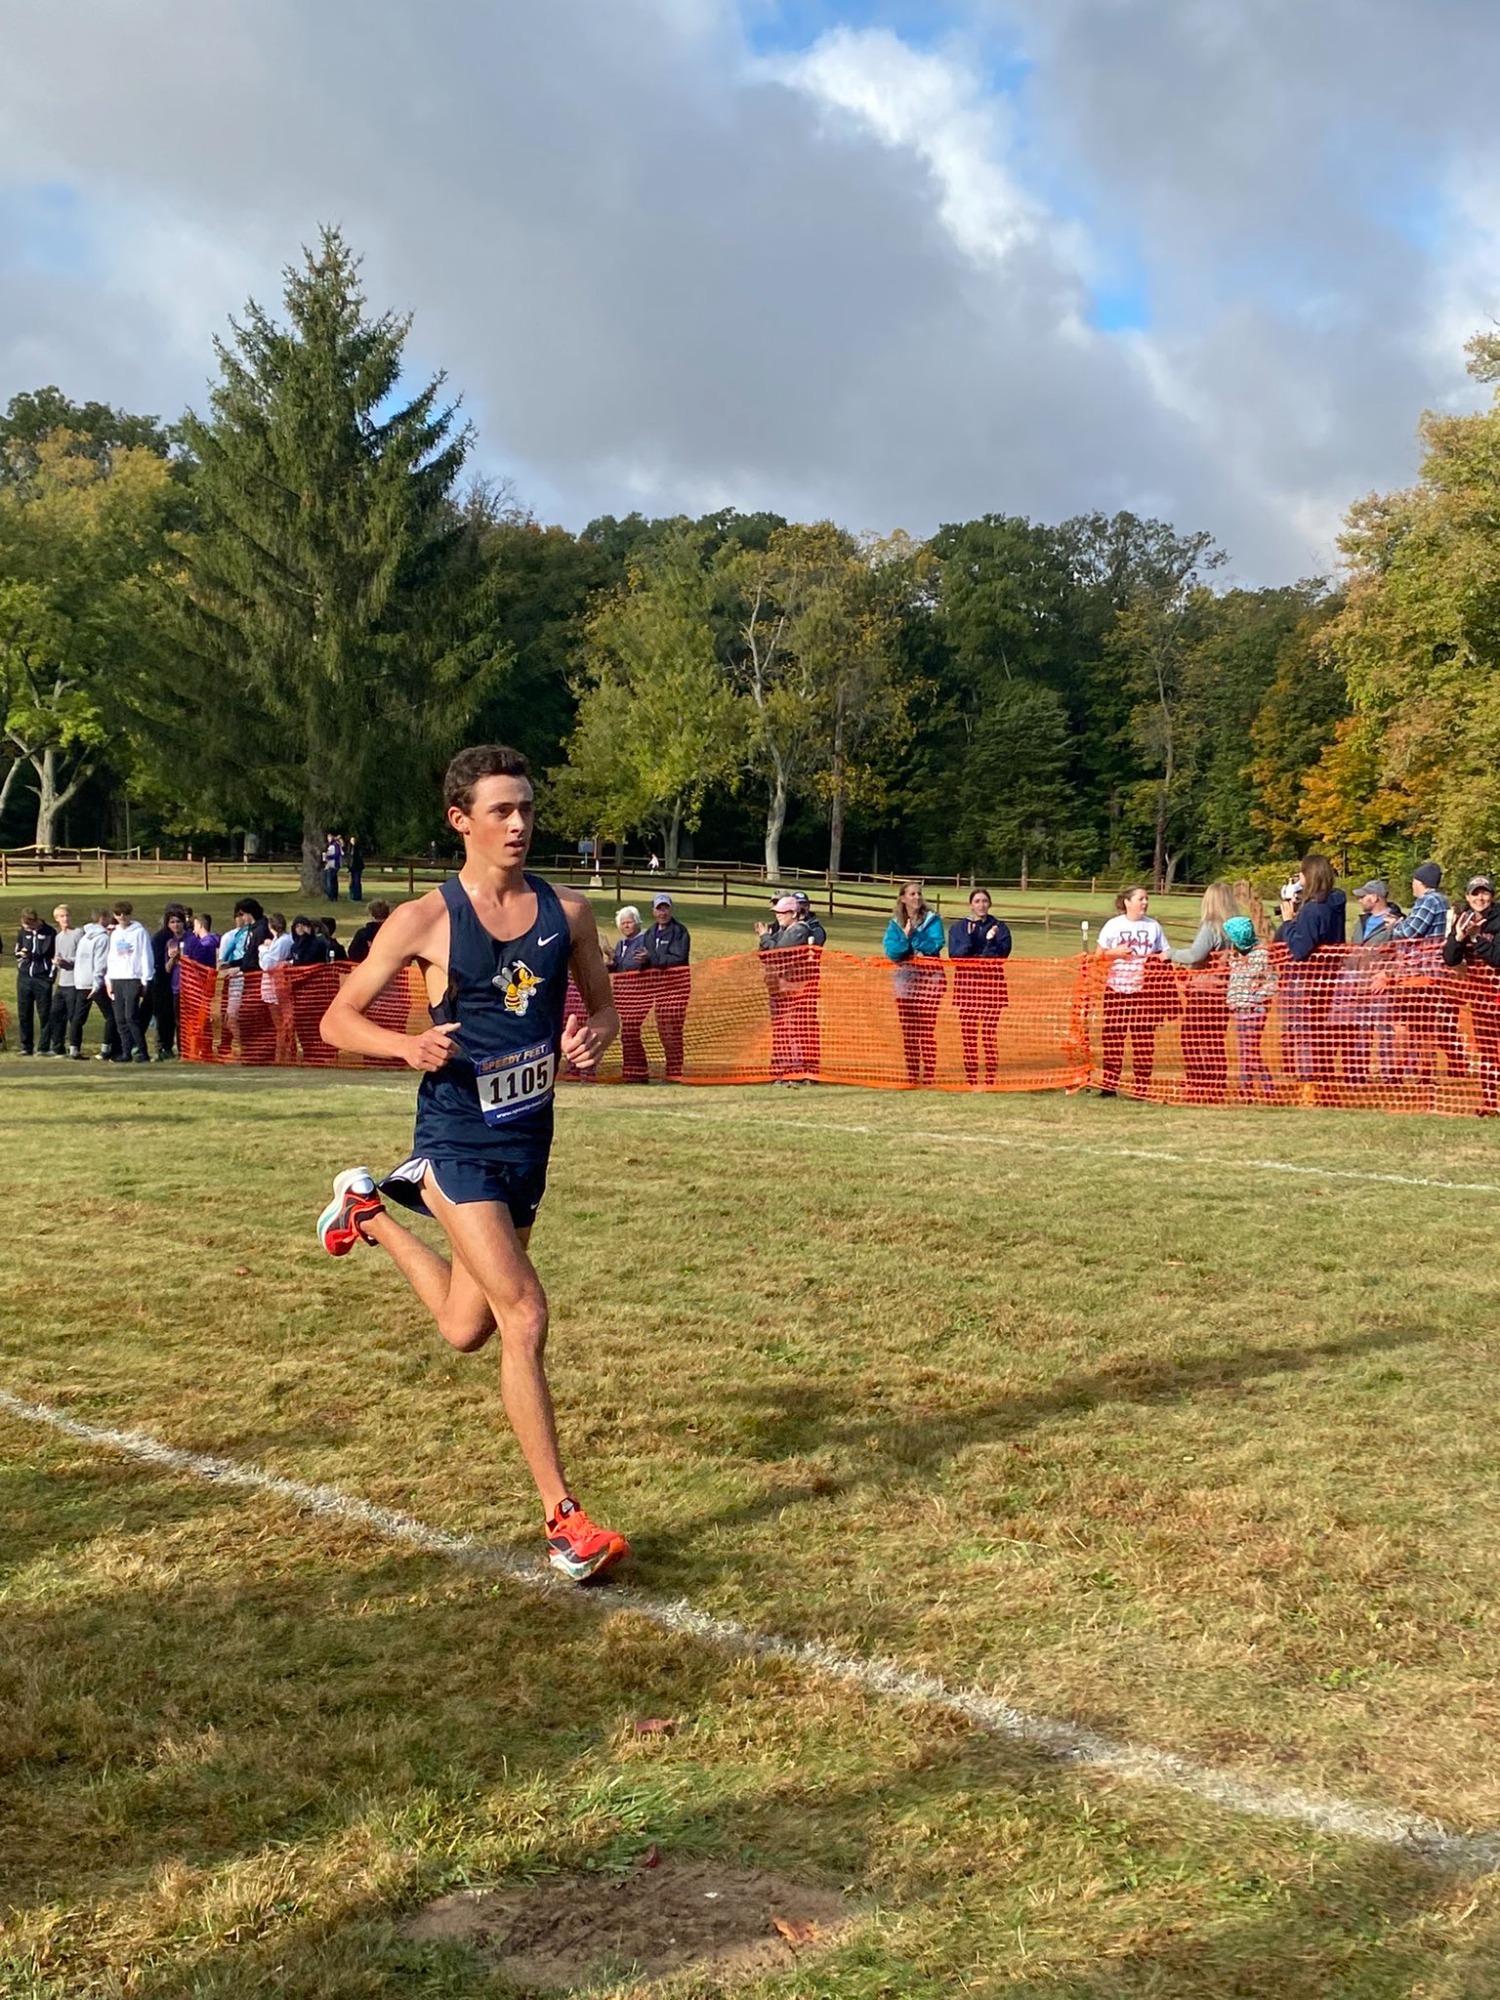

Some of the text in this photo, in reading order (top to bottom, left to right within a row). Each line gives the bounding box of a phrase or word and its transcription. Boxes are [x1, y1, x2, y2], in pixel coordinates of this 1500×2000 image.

[482, 1044, 546, 1072] SPEEDY FEET
[490, 1060, 548, 1104] 1105
